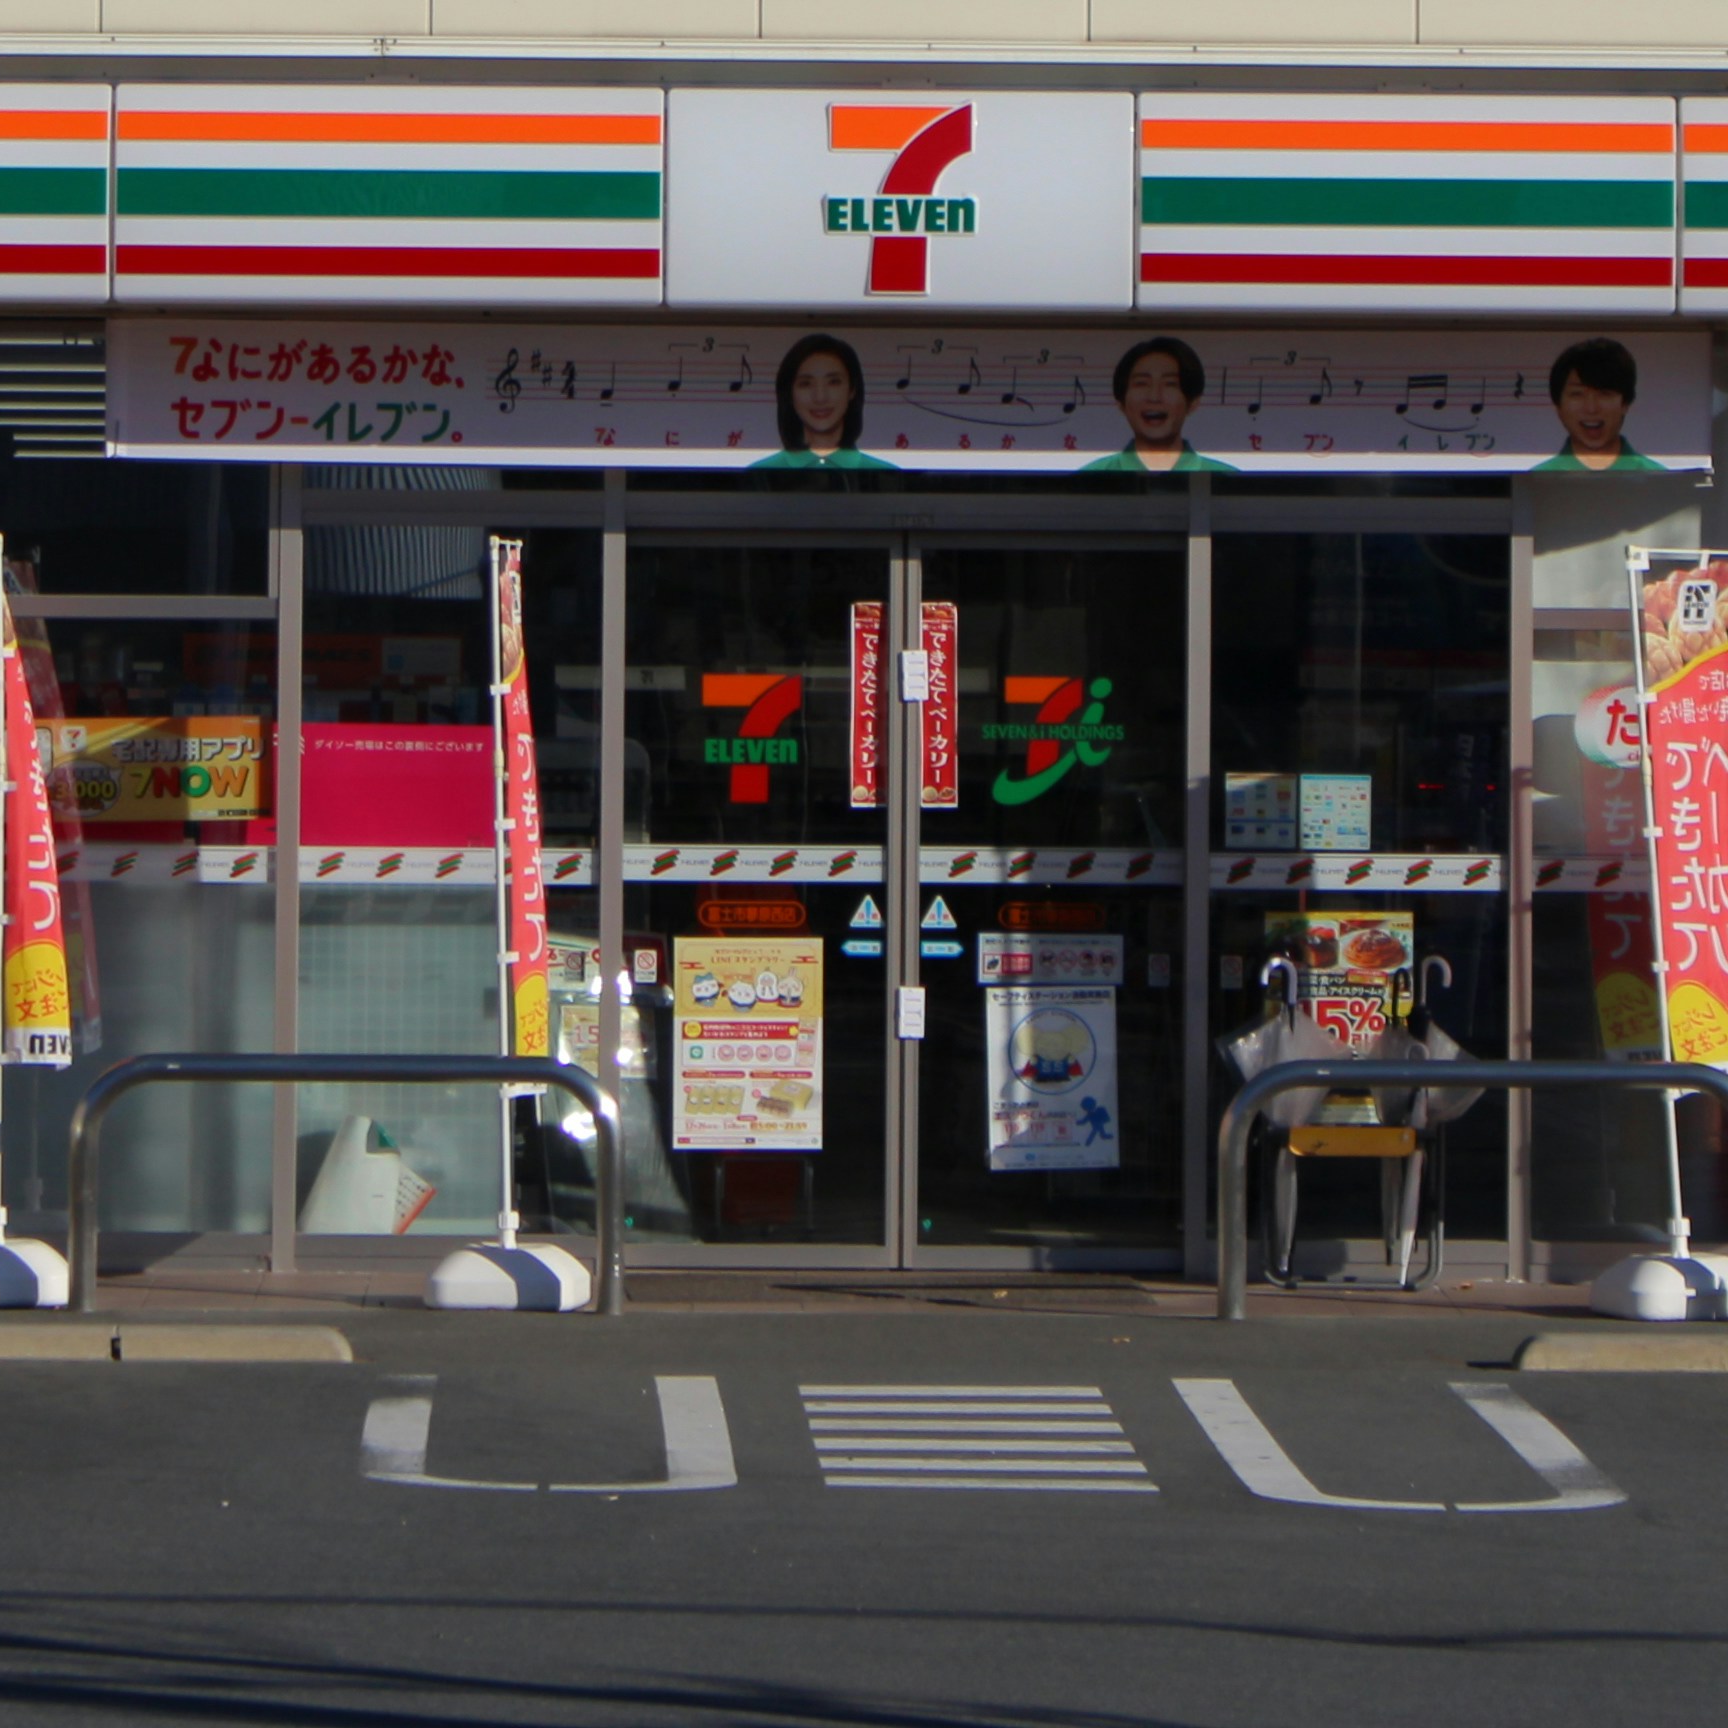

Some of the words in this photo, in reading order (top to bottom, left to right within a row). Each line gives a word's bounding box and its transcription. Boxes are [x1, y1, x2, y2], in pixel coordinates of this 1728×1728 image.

[828, 102, 974, 294] 7
[701, 673, 803, 804] 7
[928, 630, 949, 784] できたてベーカリー
[1048, 723, 1125, 741] HOLDINGS
[110, 737, 265, 763] 宅配専用アプリ
[128, 766, 250, 799] 7NOW
